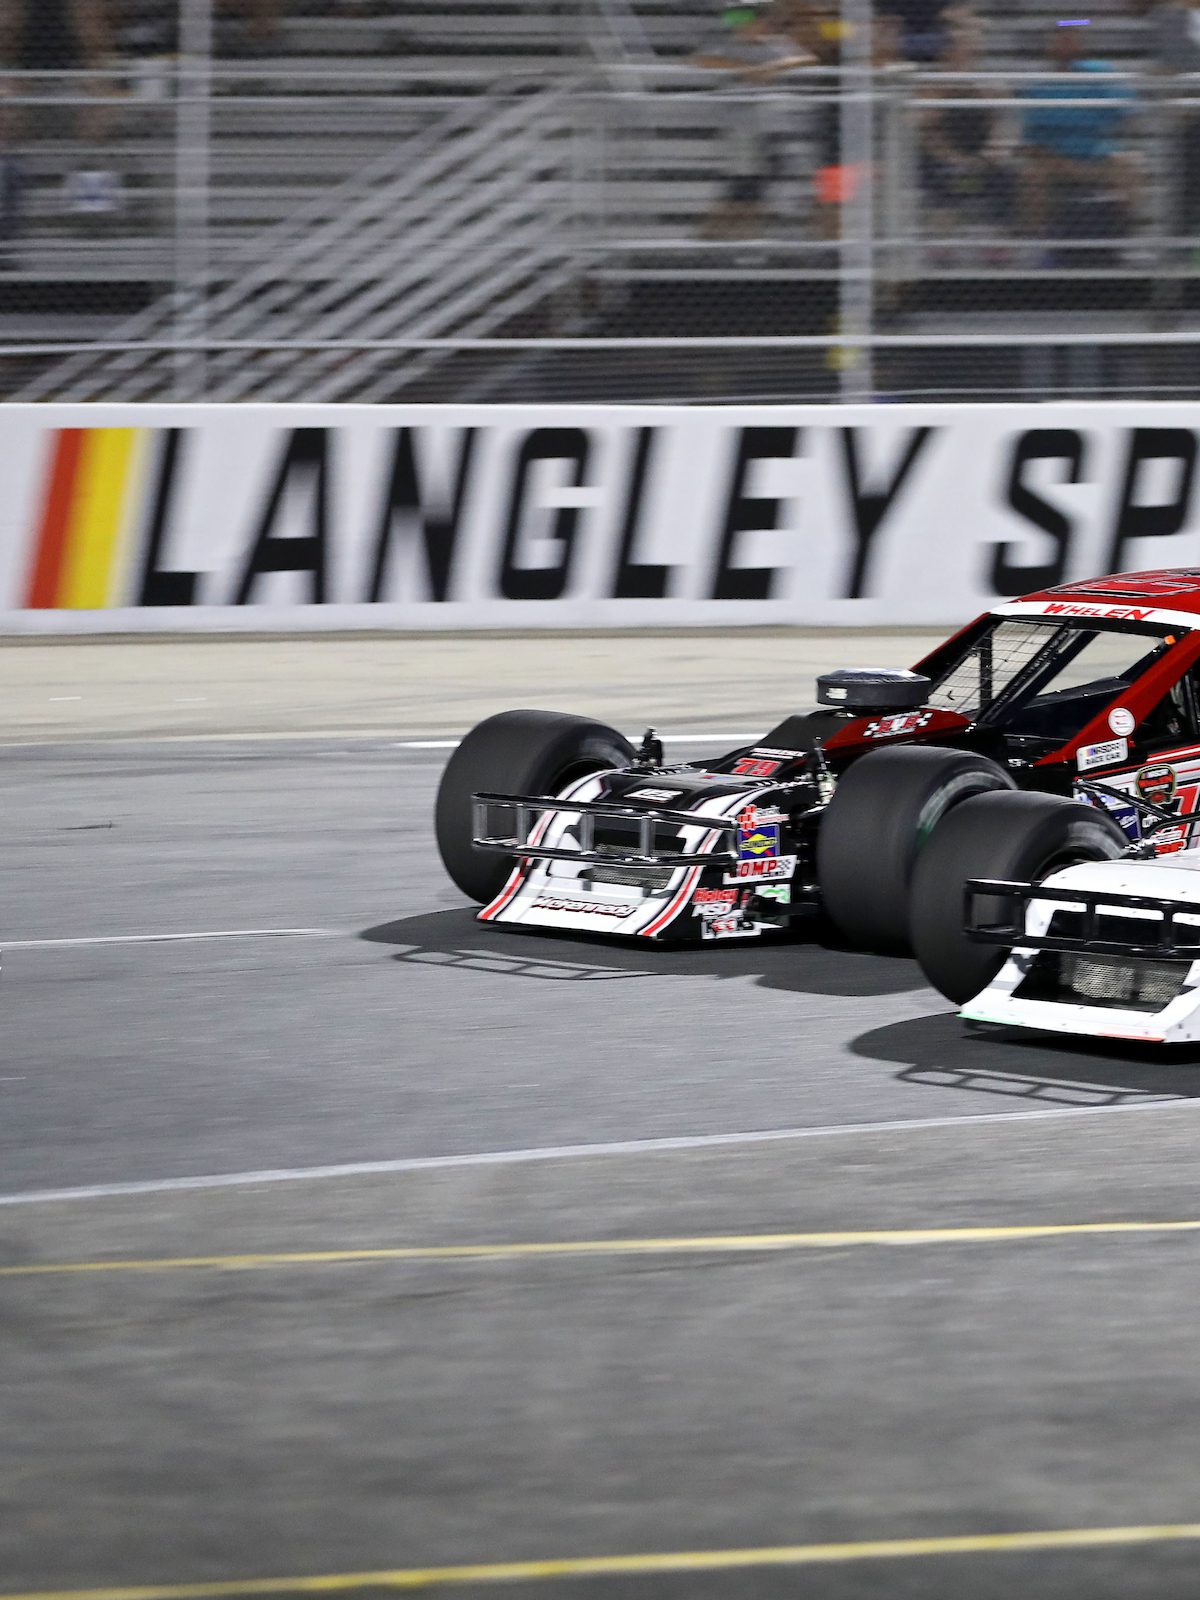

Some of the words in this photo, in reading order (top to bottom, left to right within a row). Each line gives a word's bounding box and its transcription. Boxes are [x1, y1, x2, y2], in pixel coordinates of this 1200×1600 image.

[136, 427, 934, 606] LANGLEY
[1042, 603, 1156, 620] WHELEN
[729, 859, 778, 878] OMP
